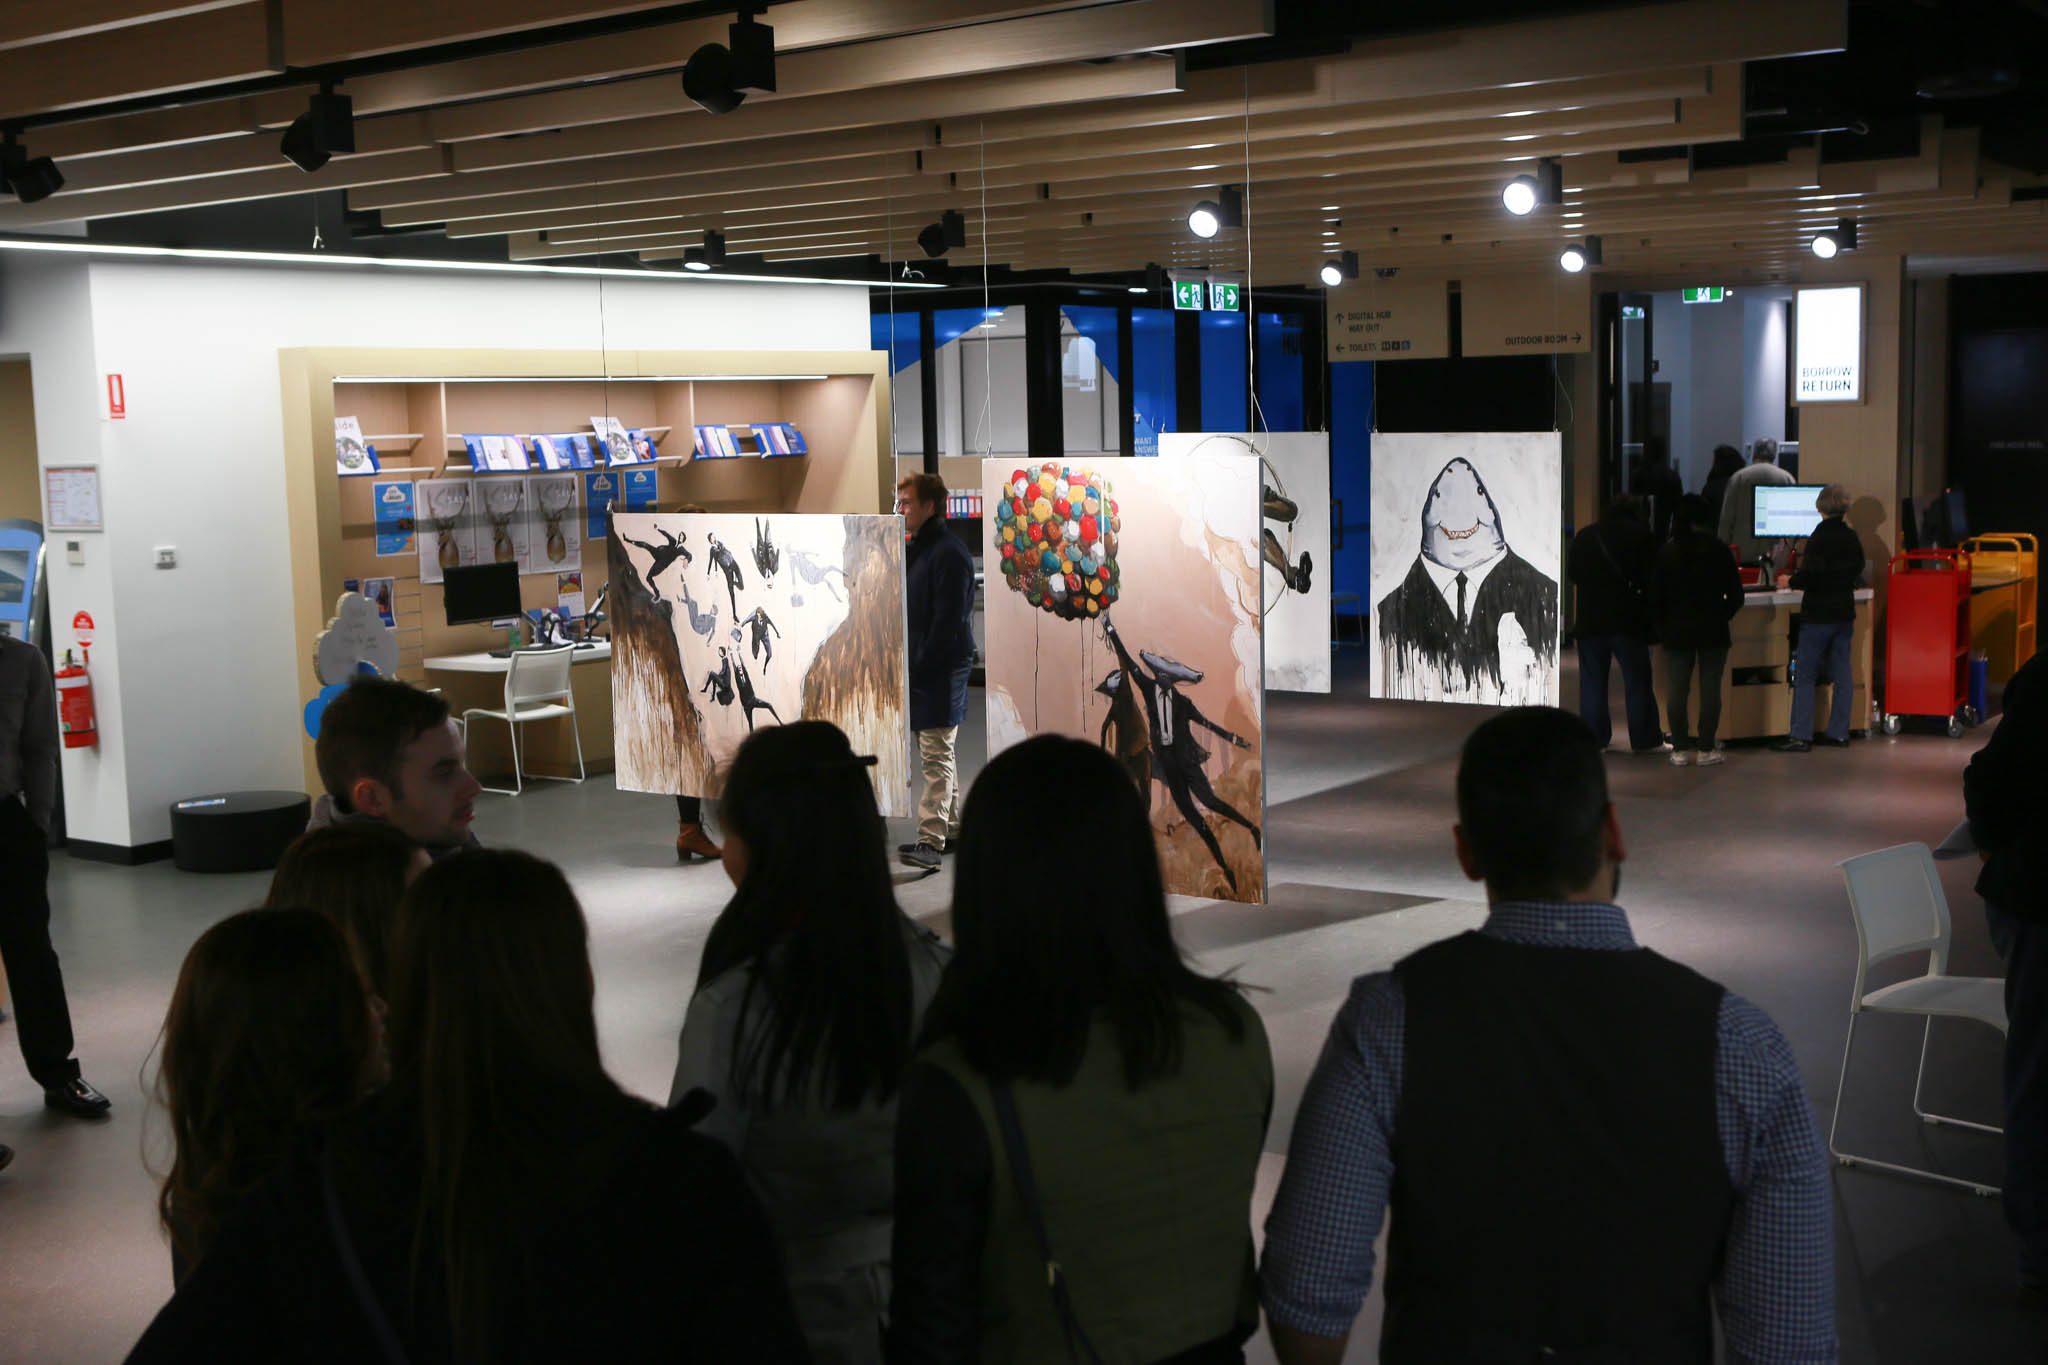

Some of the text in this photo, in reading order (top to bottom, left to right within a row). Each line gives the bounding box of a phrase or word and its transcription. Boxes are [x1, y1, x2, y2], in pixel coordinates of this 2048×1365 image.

[1348, 312, 1375, 320] DIGITAL
[1366, 323, 1380, 332] OUT
[1505, 334, 1567, 346] OUTDOOR ROOM
[1803, 367, 1852, 377] BORROW
[1803, 380, 1851, 392] RETURN
[1135, 445, 1158, 453] ANSWE
